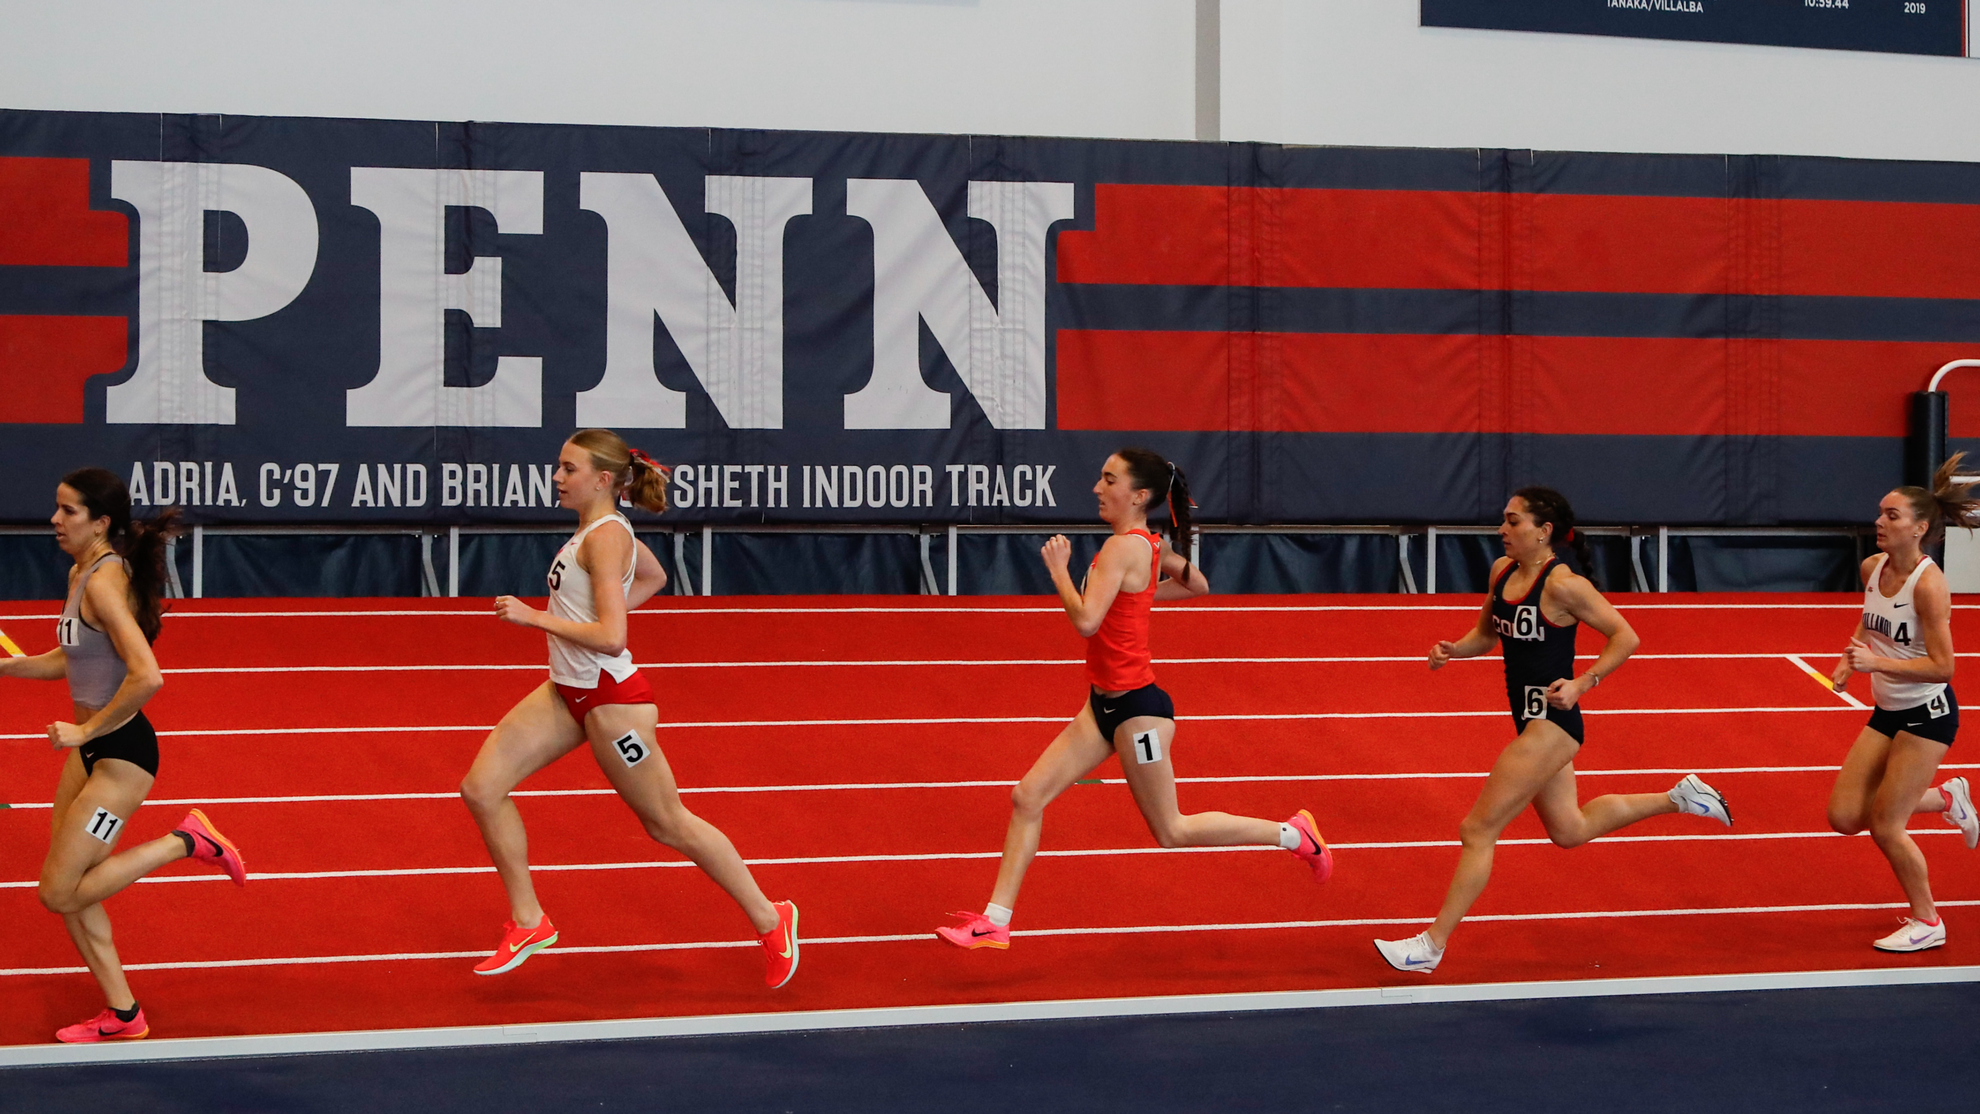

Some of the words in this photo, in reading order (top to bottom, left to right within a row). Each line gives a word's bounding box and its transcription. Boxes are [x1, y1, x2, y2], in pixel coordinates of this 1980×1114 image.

[1904, 2, 1926, 14] 2019
[107, 160, 1074, 430] PENN
[129, 461, 247, 507] ADRIA,
[259, 462, 340, 507] C'97
[351, 463, 427, 507] AND
[673, 464, 789, 509] SHETH
[803, 464, 934, 508] INDOOR
[945, 464, 1057, 508] TRACK
[548, 560, 566, 591] 5
[59, 618, 72, 645] 11
[1516, 607, 1533, 637] 6
[1893, 621, 1912, 647] 4
[1526, 687, 1544, 716] 6
[1930, 694, 1946, 714] 4
[616, 734, 644, 763] 5
[1137, 733, 1154, 762] 1
[91, 811, 118, 841] 11
